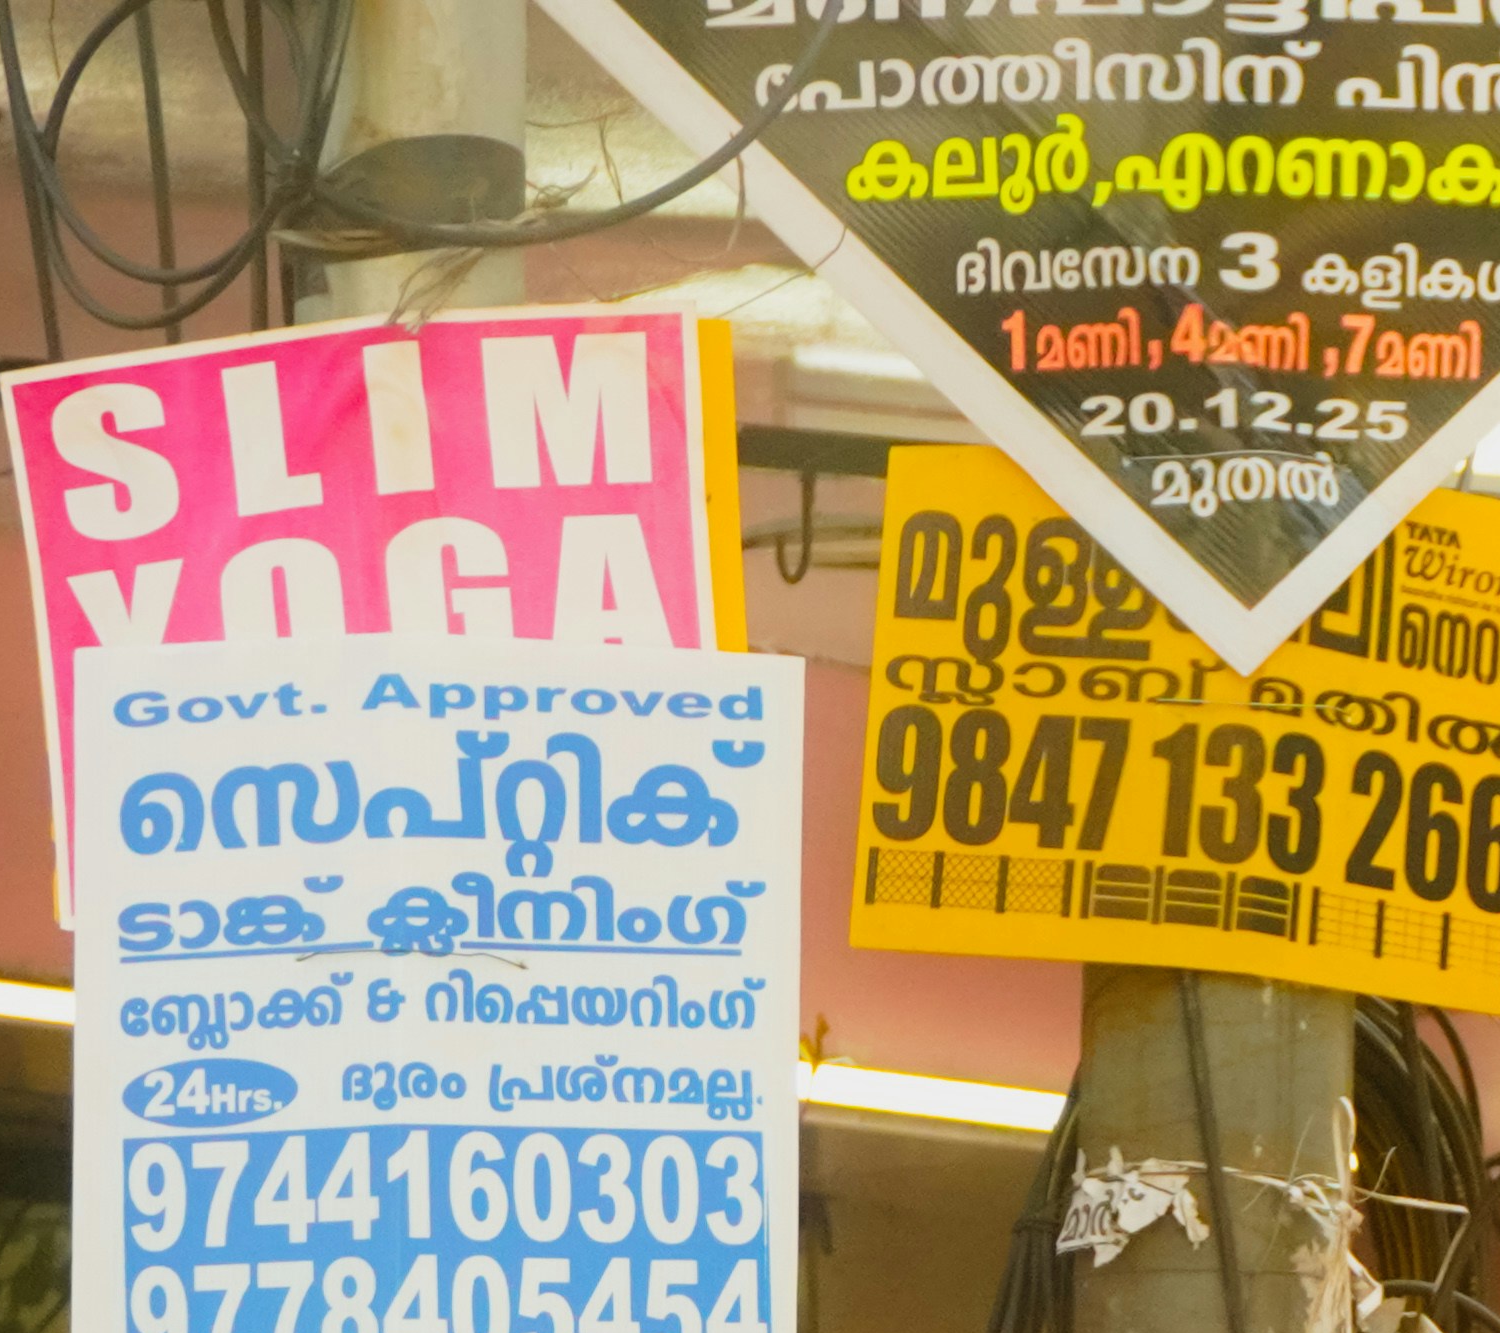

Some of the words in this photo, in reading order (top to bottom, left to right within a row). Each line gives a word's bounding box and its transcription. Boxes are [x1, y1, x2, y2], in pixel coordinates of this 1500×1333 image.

[956, 238, 1200, 295] ദിവസേന
[1219, 232, 1280, 292] 3
[50, 331, 654, 543] SLIM
[1080, 389, 1409, 444] 20.12.25
[1150, 453, 1340, 518] മുതൽ
[1405, 520, 1461, 550] TATA
[113, 681, 328, 728] Govt.
[363, 672, 765, 723] Approved
[872, 702, 1133, 853] 9847
[1152, 721, 1327, 876] 133
[366, 977, 407, 1024] &
[126, 1130, 764, 1253] 9744160303
